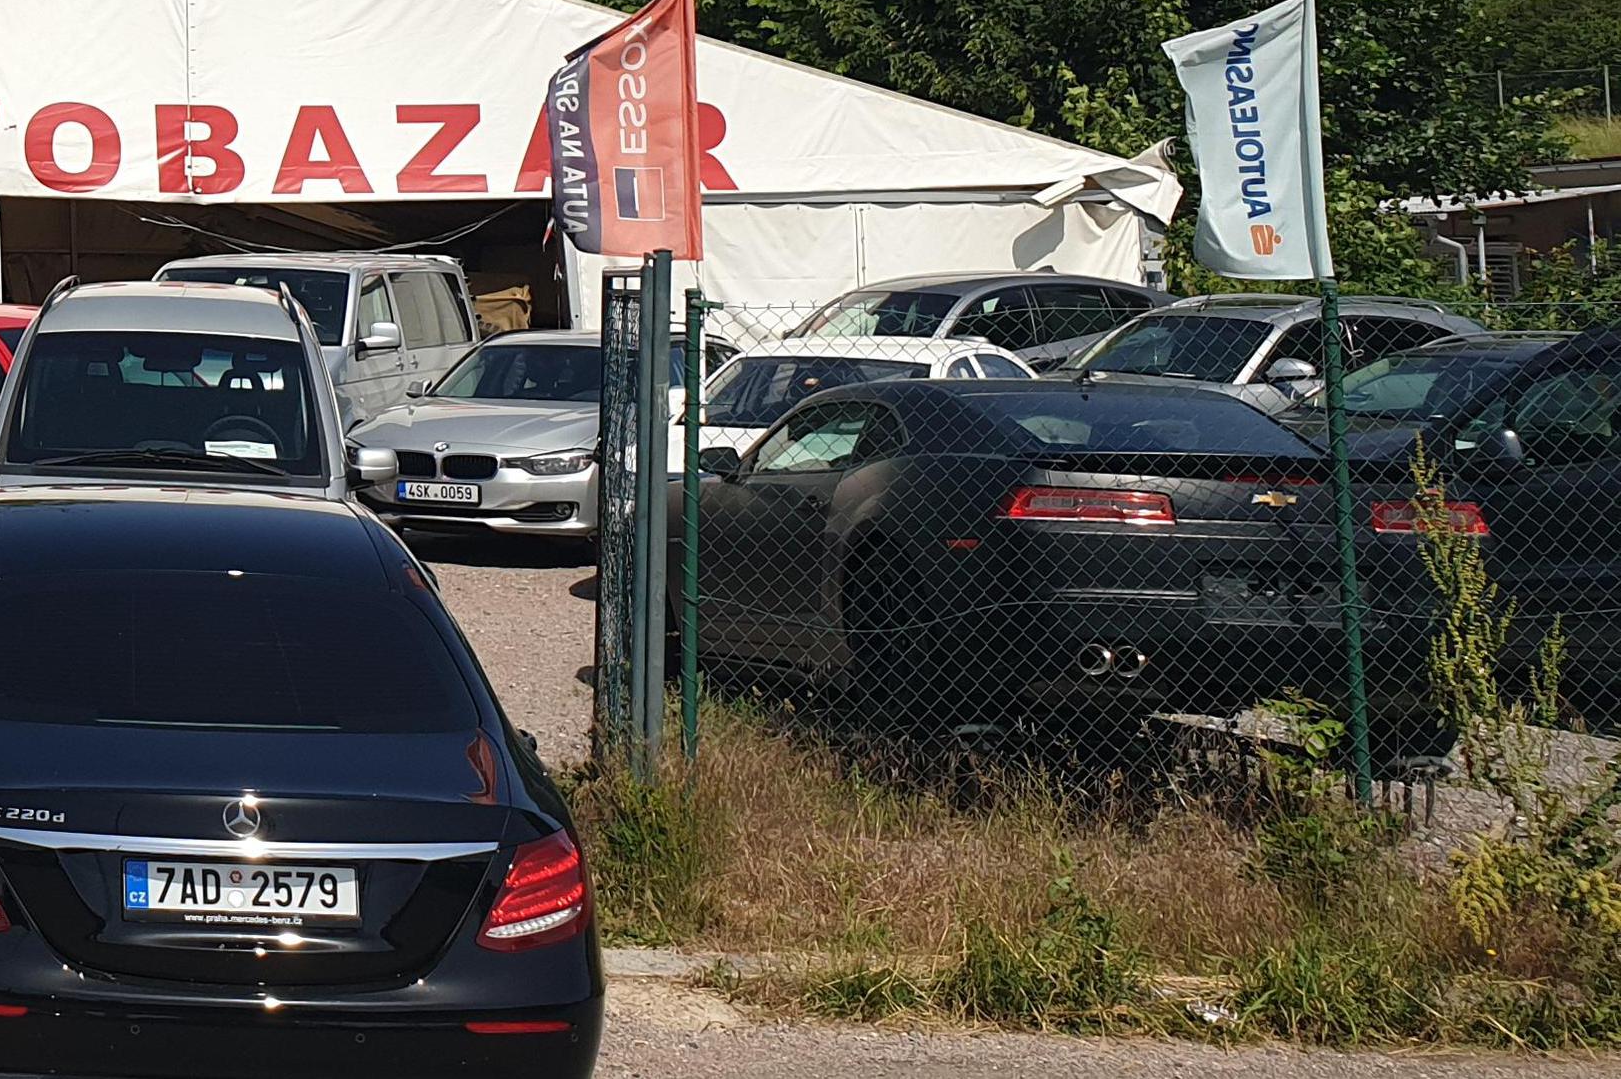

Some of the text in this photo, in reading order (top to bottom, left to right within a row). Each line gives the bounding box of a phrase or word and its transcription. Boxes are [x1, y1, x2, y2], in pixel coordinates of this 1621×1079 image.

[408, 484, 472, 500] 4SK 0059
[129, 867, 338, 908] CZ 7AD 2579
